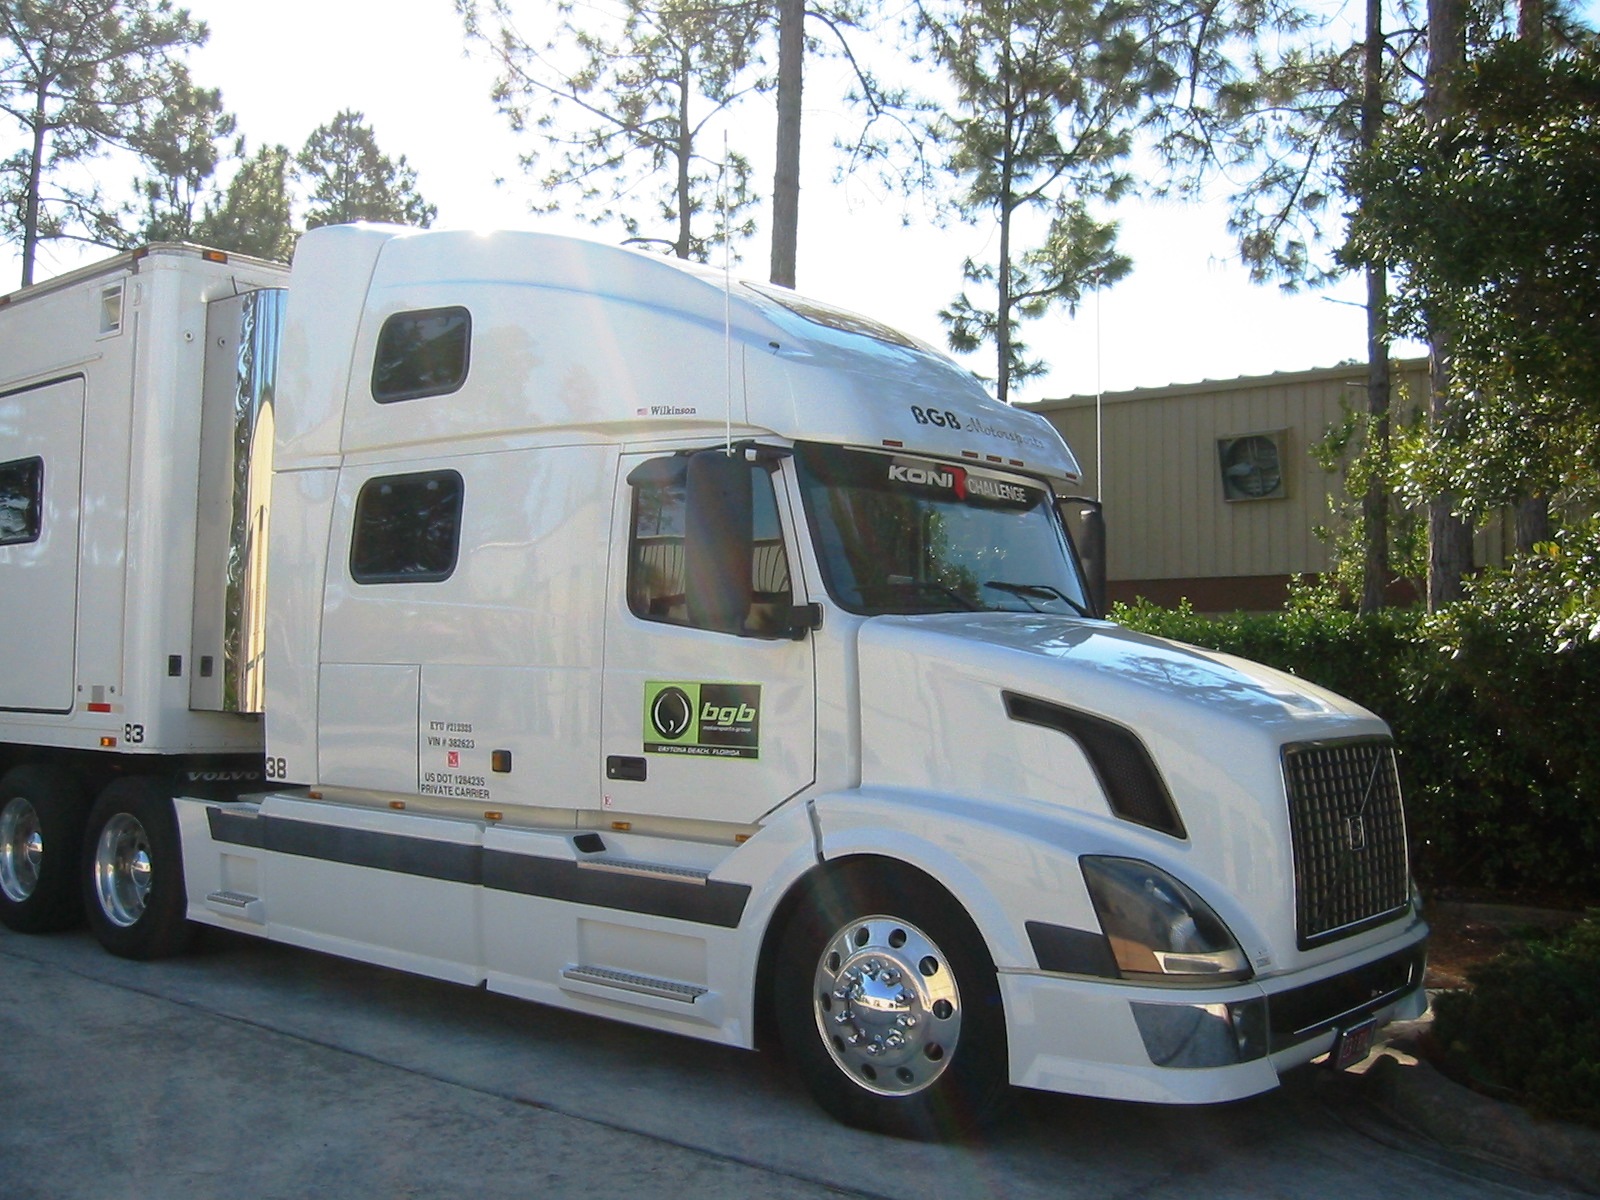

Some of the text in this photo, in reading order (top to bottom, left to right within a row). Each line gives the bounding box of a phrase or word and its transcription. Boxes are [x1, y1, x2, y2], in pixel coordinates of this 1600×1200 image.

[650, 405, 697, 416] Wilkinson
[910, 405, 962, 430] BGB
[888, 465, 1027, 503] KONI CHALLENGE
[700, 702, 757, 726] bgb
[124, 723, 145, 743] 83
[428, 736, 441, 747] VIN
[186, 771, 260, 782] VOLVO
[266, 757, 287, 779] 38
[424, 772, 436, 783] US
[437, 773, 453, 784] DOT
[421, 784, 490, 800] PRIVATE CARRIER
